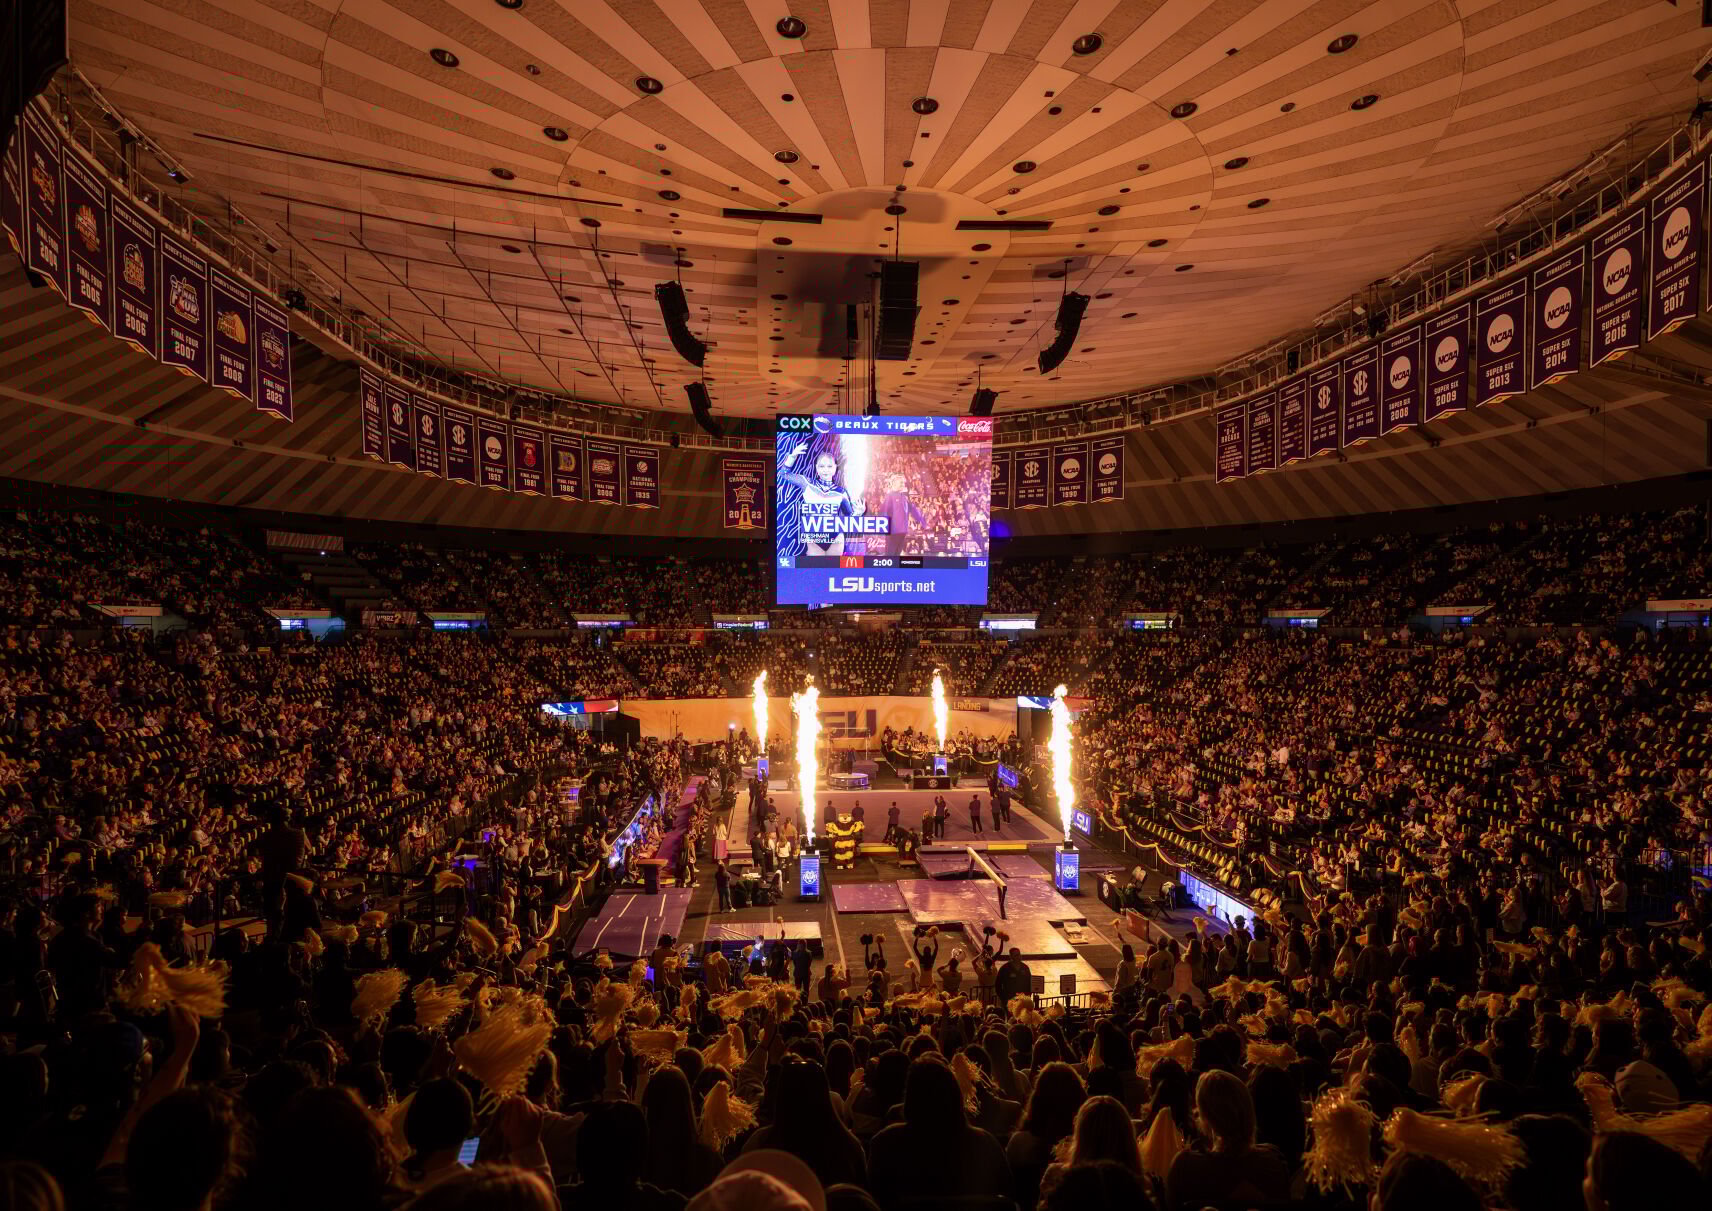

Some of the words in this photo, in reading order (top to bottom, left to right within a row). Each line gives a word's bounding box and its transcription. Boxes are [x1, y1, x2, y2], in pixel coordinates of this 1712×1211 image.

[1664, 181, 1691, 204] GYMNASTICS
[1604, 224, 1631, 245] GYMNASTICS
[1665, 225, 1690, 252] NCAA
[1546, 260, 1571, 278] GYMNASTICS
[1606, 264, 1631, 287] NCAA
[81, 280, 100, 306] 2005
[1660, 280, 1678, 300] SUPER
[1679, 276, 1690, 289] SIX
[1489, 290, 1513, 305] GYMNASTICS
[1596, 300, 1614, 313] NATIONAL
[1615, 289, 1638, 305] RUNNER-UP
[1663, 292, 1685, 316] 2017
[122, 300, 135, 314] FINAL
[1547, 303, 1571, 322] NCAA
[126, 313, 146, 336] 2006
[1602, 314, 1620, 331] SUPER
[1621, 310, 1631, 322] SIX
[171, 328, 184, 341] FINAL
[186, 336, 198, 348] FOUR
[1490, 329, 1513, 346] NCAA
[1604, 324, 1627, 345] 2016
[175, 341, 195, 360] 2007
[1542, 344, 1560, 356] SUPER
[1561, 340, 1571, 350] SIX
[220, 354, 232, 365] FINAL
[1438, 350, 1459, 365] NCAA
[1545, 354, 1567, 369] 2014
[223, 365, 242, 383] 2008
[1392, 370, 1410, 382] NCAA
[1486, 365, 1504, 378] SUPER
[1505, 362, 1514, 371] SIX
[264, 378, 274, 389] FINAL
[1353, 371, 1368, 396] SEC
[1434, 383, 1450, 394] SUPER
[1489, 373, 1510, 389] 2013
[266, 389, 283, 405] 2023
[1318, 386, 1331, 409] SEC
[1436, 391, 1457, 406] 2009
[1390, 407, 1408, 421] 2008
[780, 417, 810, 428] COX
[958, 421, 992, 432] Coca-Cola
[452, 425, 466, 445] SEC
[992, 464, 1000, 480] EC
[1024, 461, 1039, 477] SEC
[752, 511, 762, 519] 23
[802, 504, 837, 513] ELYSE
[802, 517, 888, 532] WENNER
[829, 577, 935, 594] LSUsports.net
